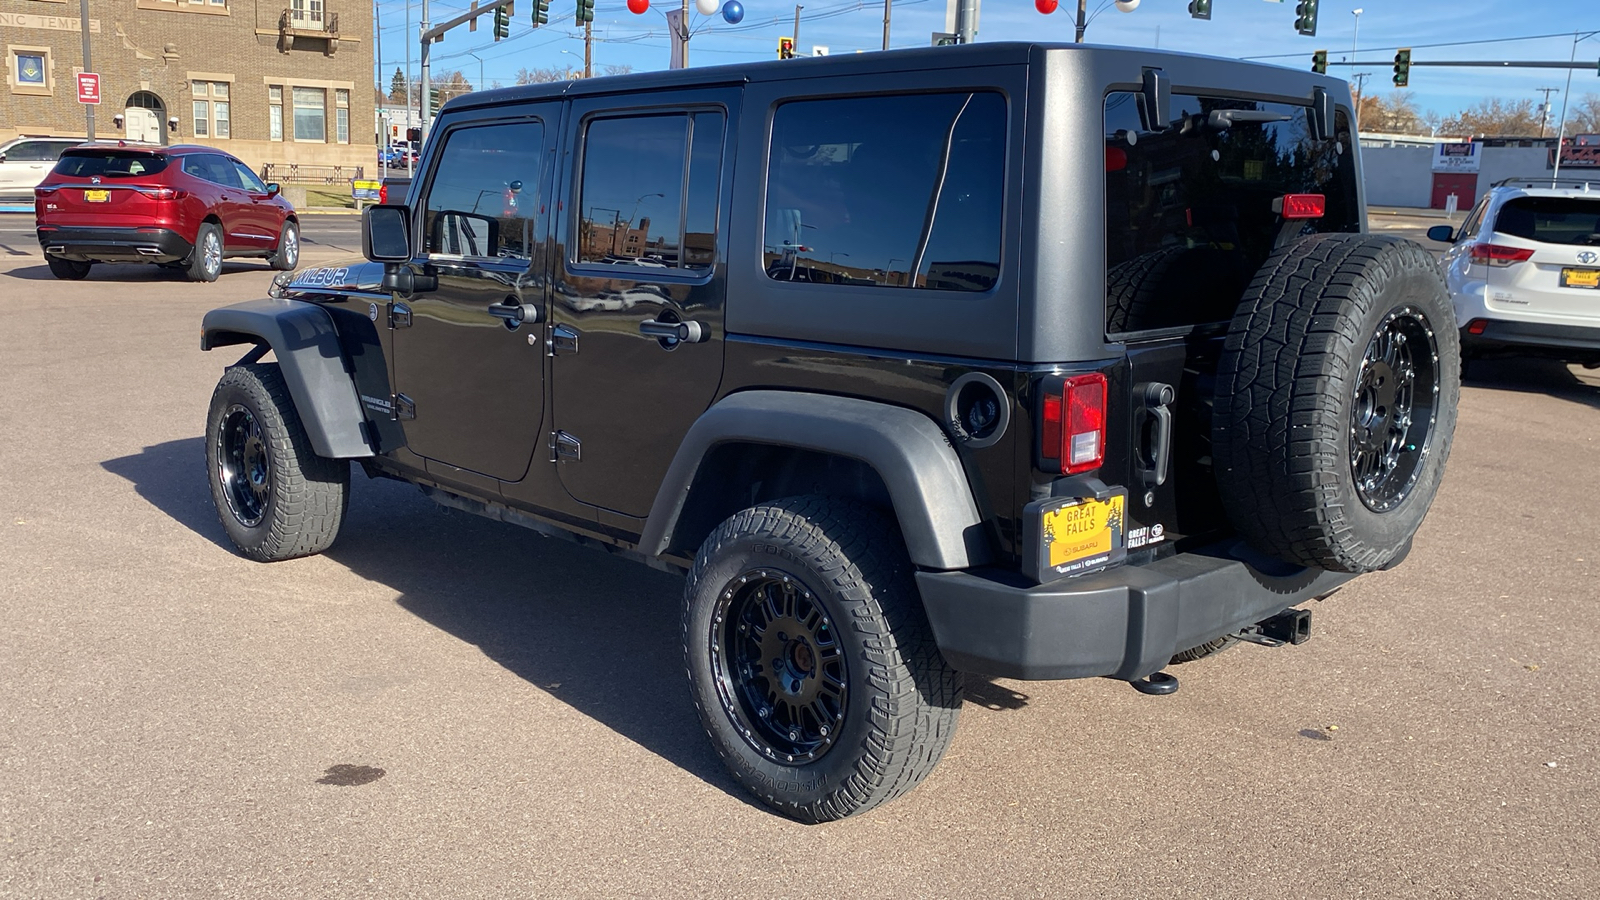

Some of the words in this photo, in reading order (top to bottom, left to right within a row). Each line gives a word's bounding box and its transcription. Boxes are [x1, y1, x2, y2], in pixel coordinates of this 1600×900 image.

[294, 267, 349, 286] WILBUR
[361, 394, 391, 408] WRANGLE
[1067, 506, 1096, 522] GREAT
[1067, 519, 1095, 536] FALLS
[1128, 527, 1146, 539] GREAT
[1072, 541, 1098, 554] SUBARU
[1128, 536, 1146, 549] FALLS
